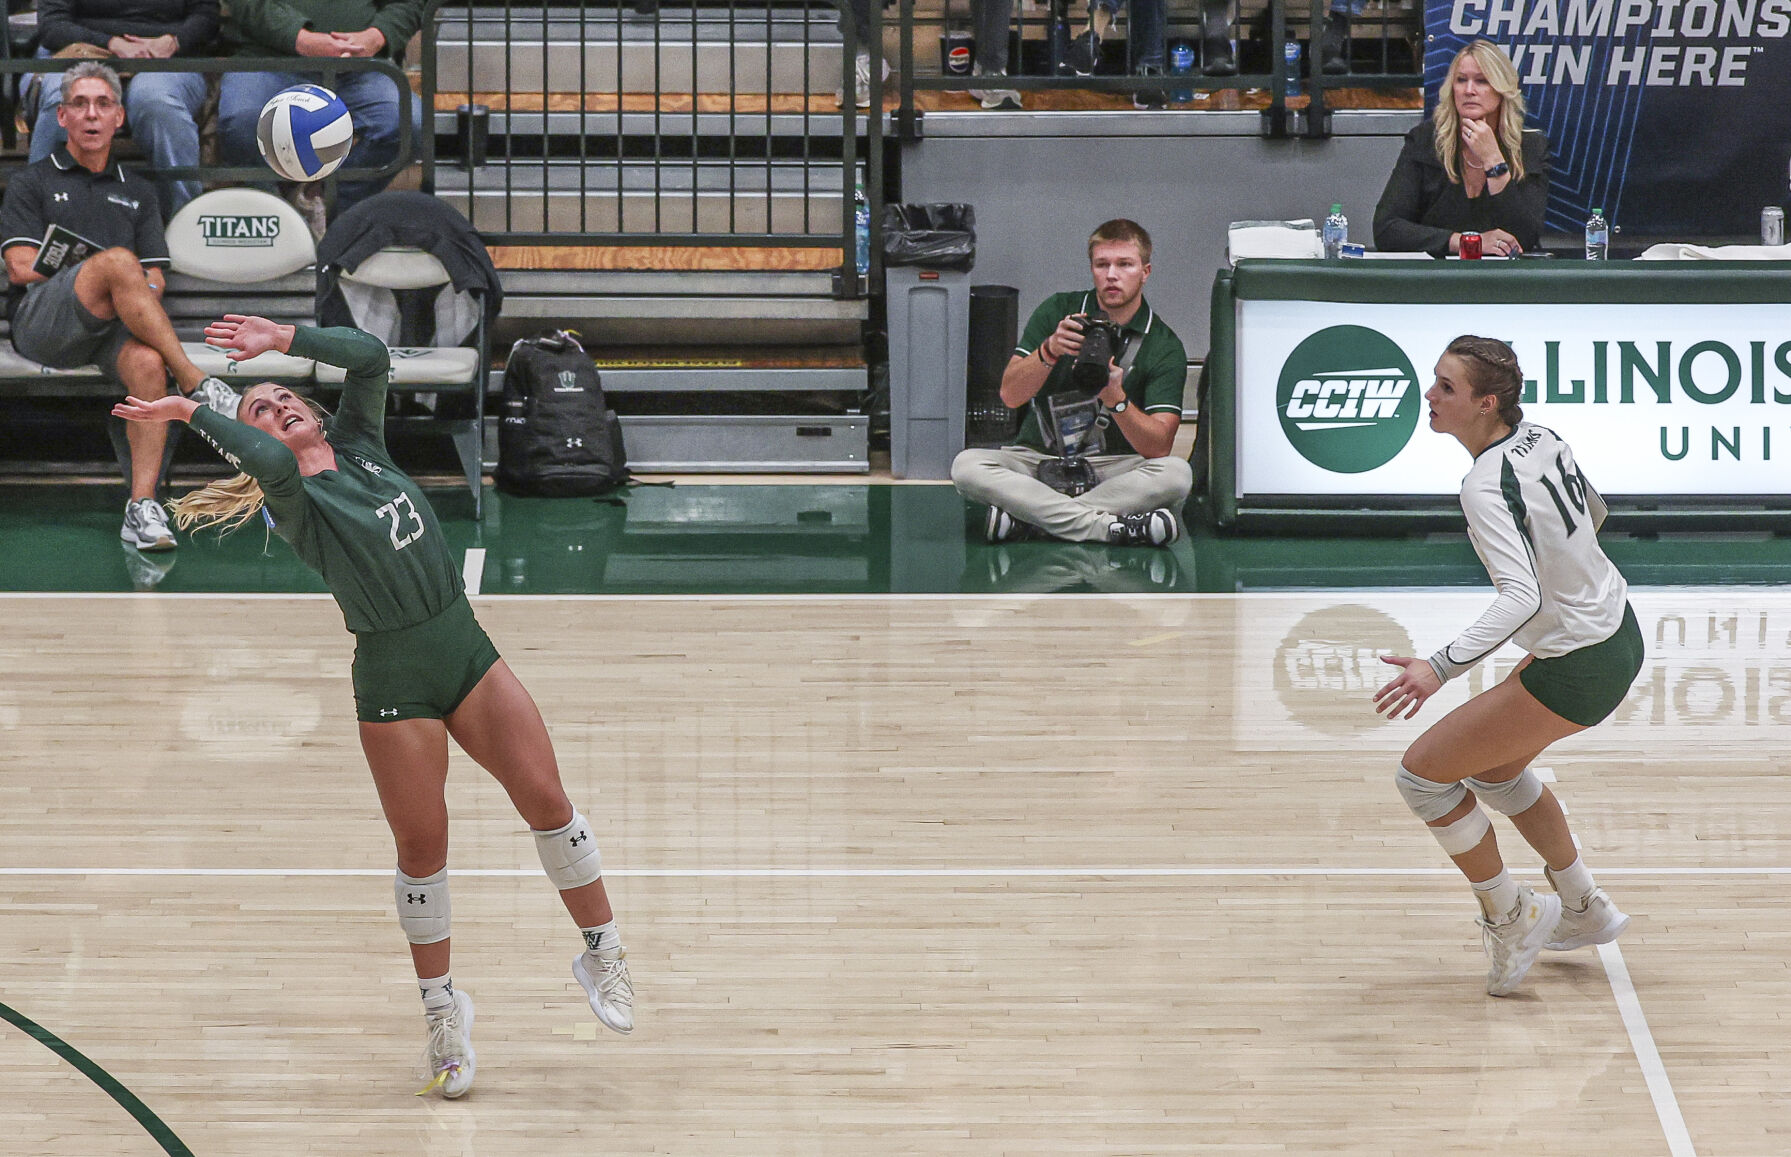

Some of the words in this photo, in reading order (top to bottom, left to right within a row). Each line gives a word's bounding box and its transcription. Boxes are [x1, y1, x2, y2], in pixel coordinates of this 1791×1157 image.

[1449, 0, 1791, 38] CHAMPIONS
[200, 217, 278, 237] TITANS
[1503, 339, 1791, 405] LINOI
[1286, 379, 1411, 418] CCIW
[1660, 426, 1791, 461] UNI
[1537, 450, 1587, 538] 16
[376, 491, 424, 551] 23
